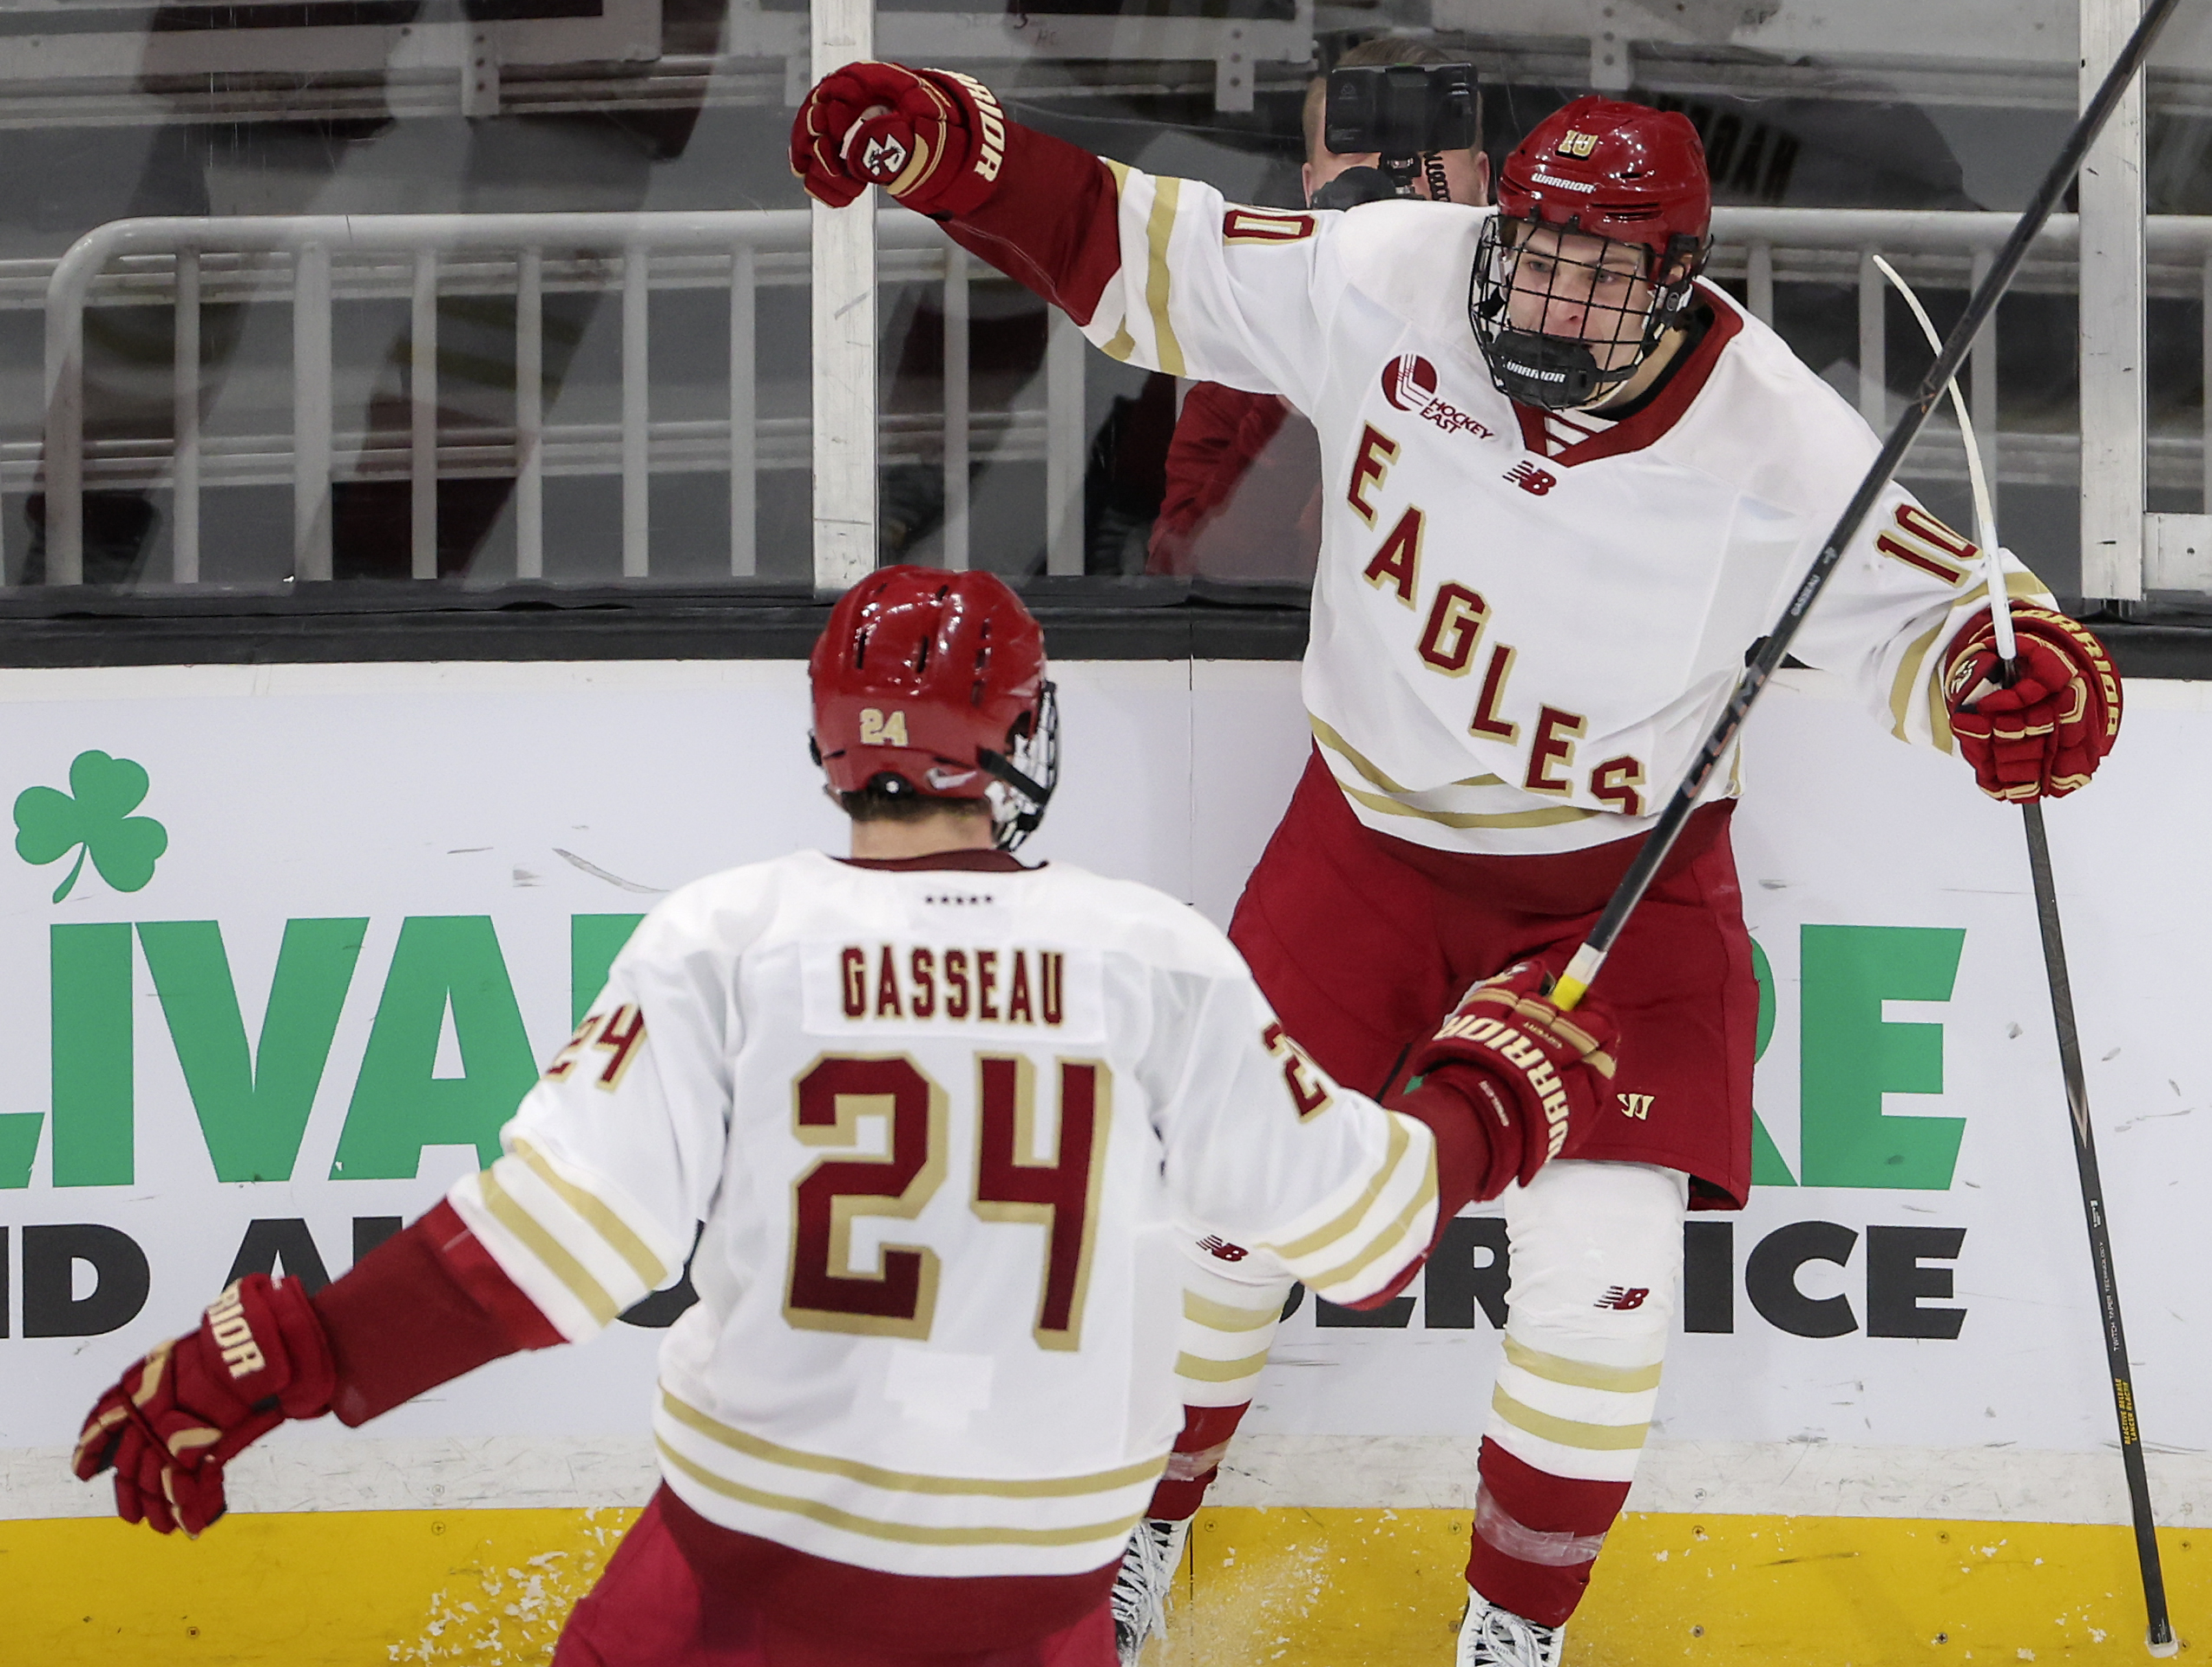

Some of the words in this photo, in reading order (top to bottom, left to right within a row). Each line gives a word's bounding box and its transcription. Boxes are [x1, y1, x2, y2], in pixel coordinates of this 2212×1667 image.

[922, 67, 1006, 182] RIOR
[1531, 173, 1596, 194] WARRIOR
[1420, 405, 1461, 434] EAST
[1429, 397, 1494, 440] HOCKEY
[1873, 501, 1984, 588] 10
[1347, 419, 1646, 816] EAGLES
[859, 706, 909, 747] 24
[839, 943, 1066, 1027] GASSEAU
[0, 914, 647, 1189] IVA
[1432, 1014, 1570, 1164] WARRIOR
[783, 1049, 1113, 1353] 24
